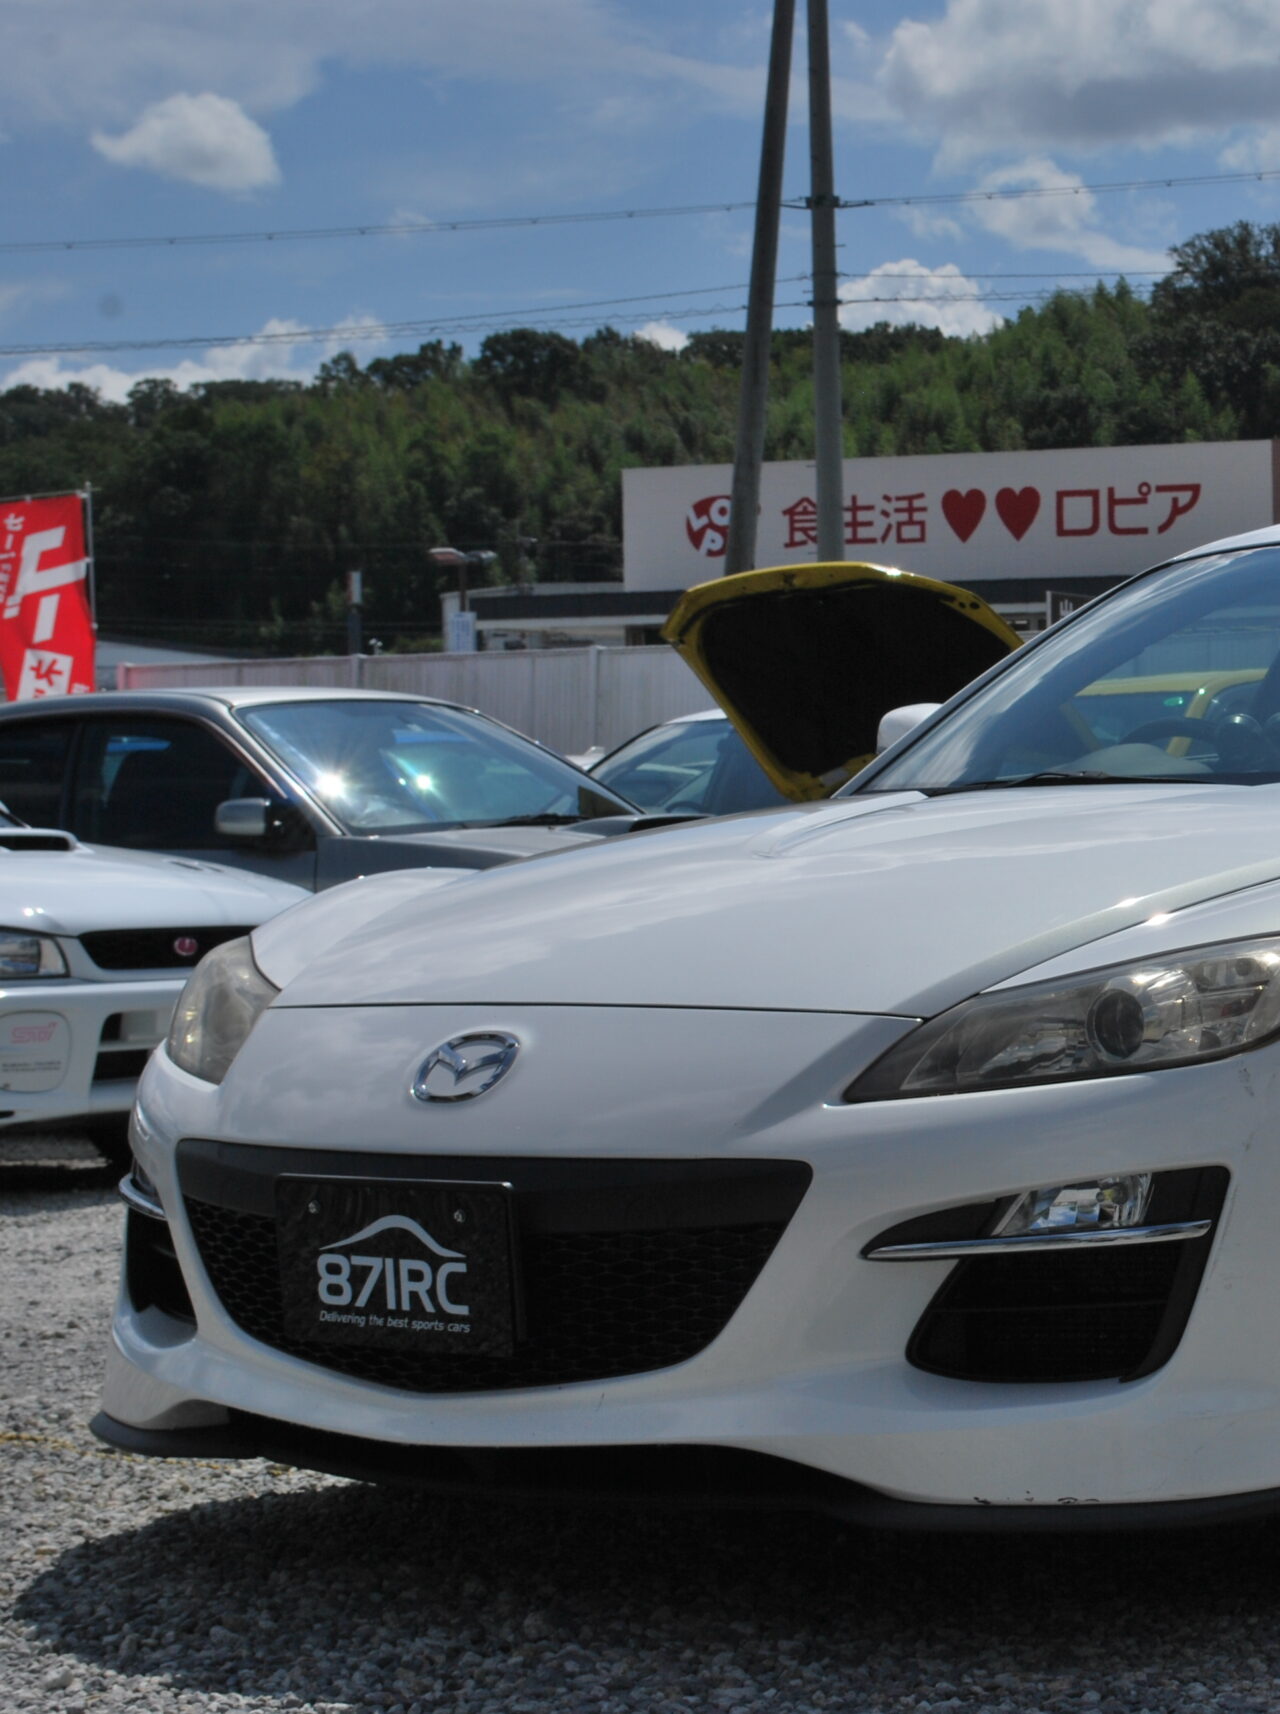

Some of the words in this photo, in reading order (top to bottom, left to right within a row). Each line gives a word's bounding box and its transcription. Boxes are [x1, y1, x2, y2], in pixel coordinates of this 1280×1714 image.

[782, 492, 929, 549] 食生活
[1055, 481, 1202, 538] ロピア
[317, 1253, 470, 1316] 871RC
[319, 1310, 366, 1327] Delivering
[368, 1314, 384, 1327] the
[387, 1316, 409, 1329] best
[411, 1318, 444, 1332] sports
[447, 1322, 472, 1334] cars
